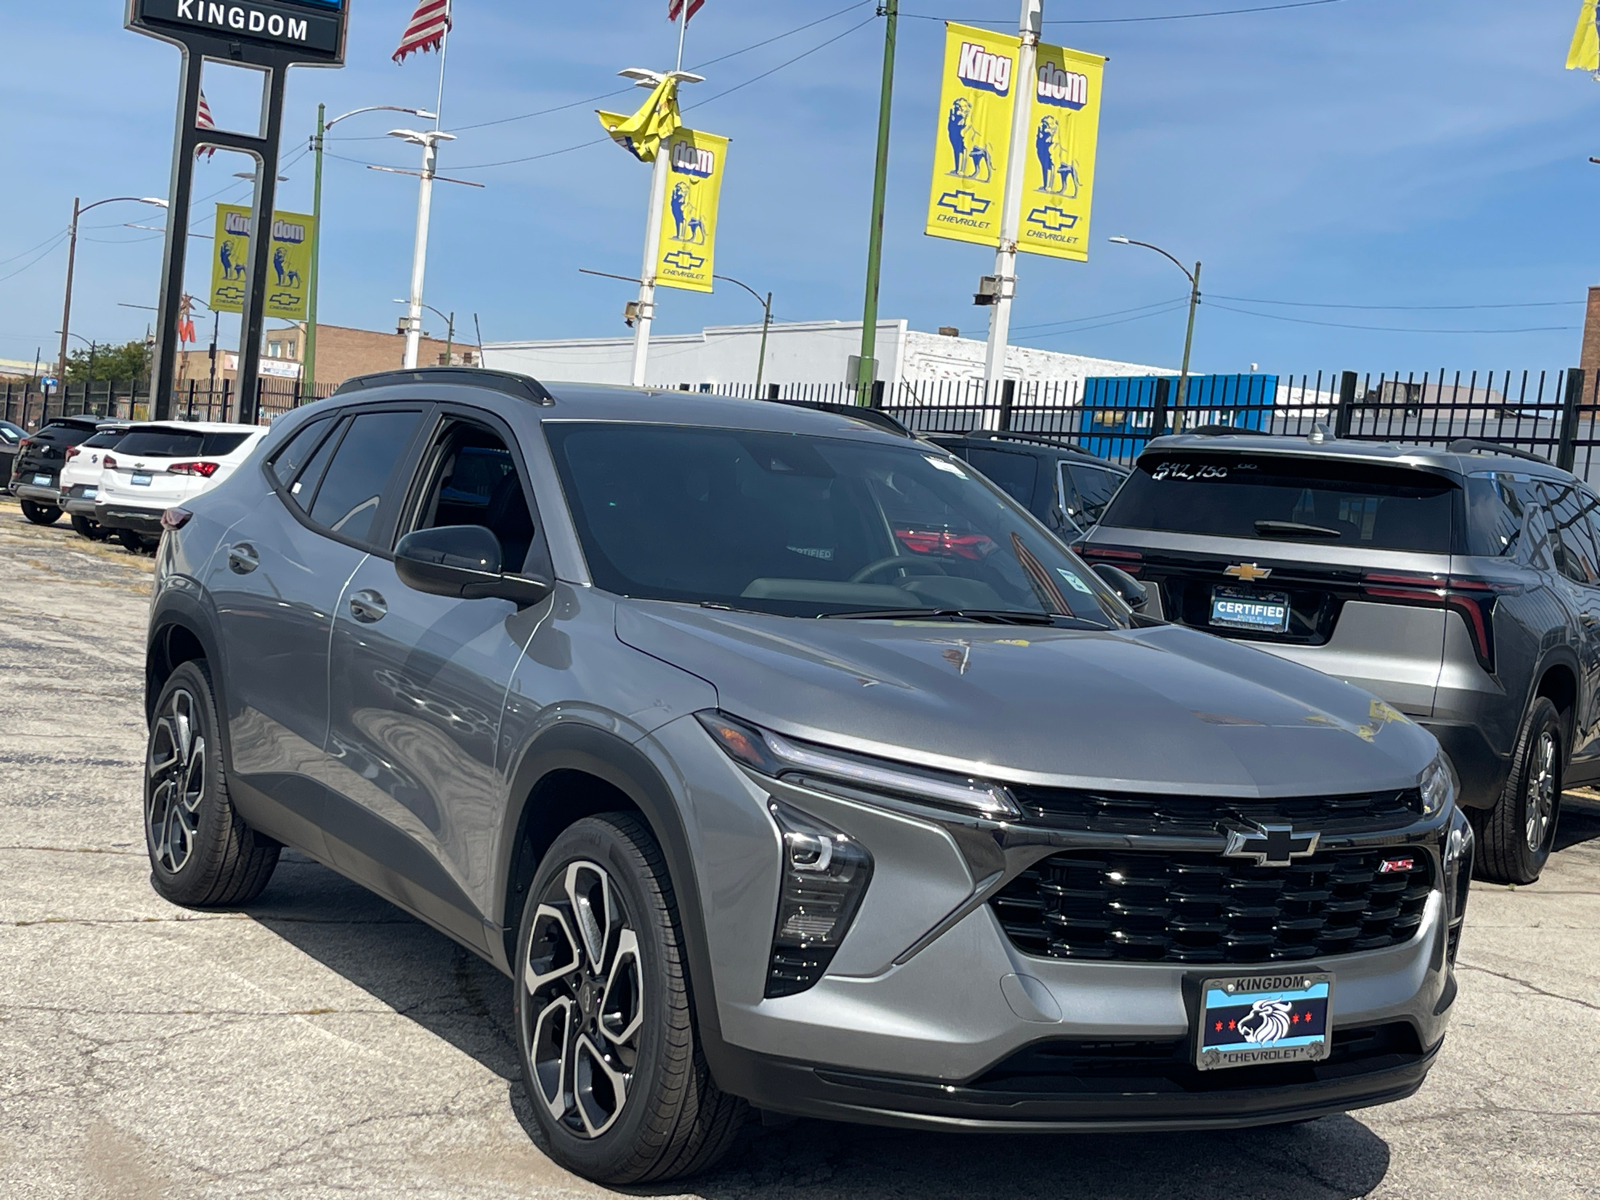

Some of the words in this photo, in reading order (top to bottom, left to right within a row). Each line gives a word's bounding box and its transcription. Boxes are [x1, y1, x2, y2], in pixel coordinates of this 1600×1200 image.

[177, 0, 307, 40] KINGDOM
[957, 42, 1012, 95] King
[1036, 61, 1087, 107] dom
[672, 141, 714, 176] dom
[936, 213, 989, 229] CHEVROLET
[273, 219, 304, 242] dom
[1026, 229, 1077, 244] CHEVROLET
[661, 268, 705, 280] CHEVROLET
[1151, 462, 1227, 480] $42,750
[1217, 601, 1284, 618] CERTIFIED
[1380, 859, 1414, 873] RS
[1235, 976, 1304, 991] KINGDOM
[1228, 1048, 1299, 1063] CHEVROLET
